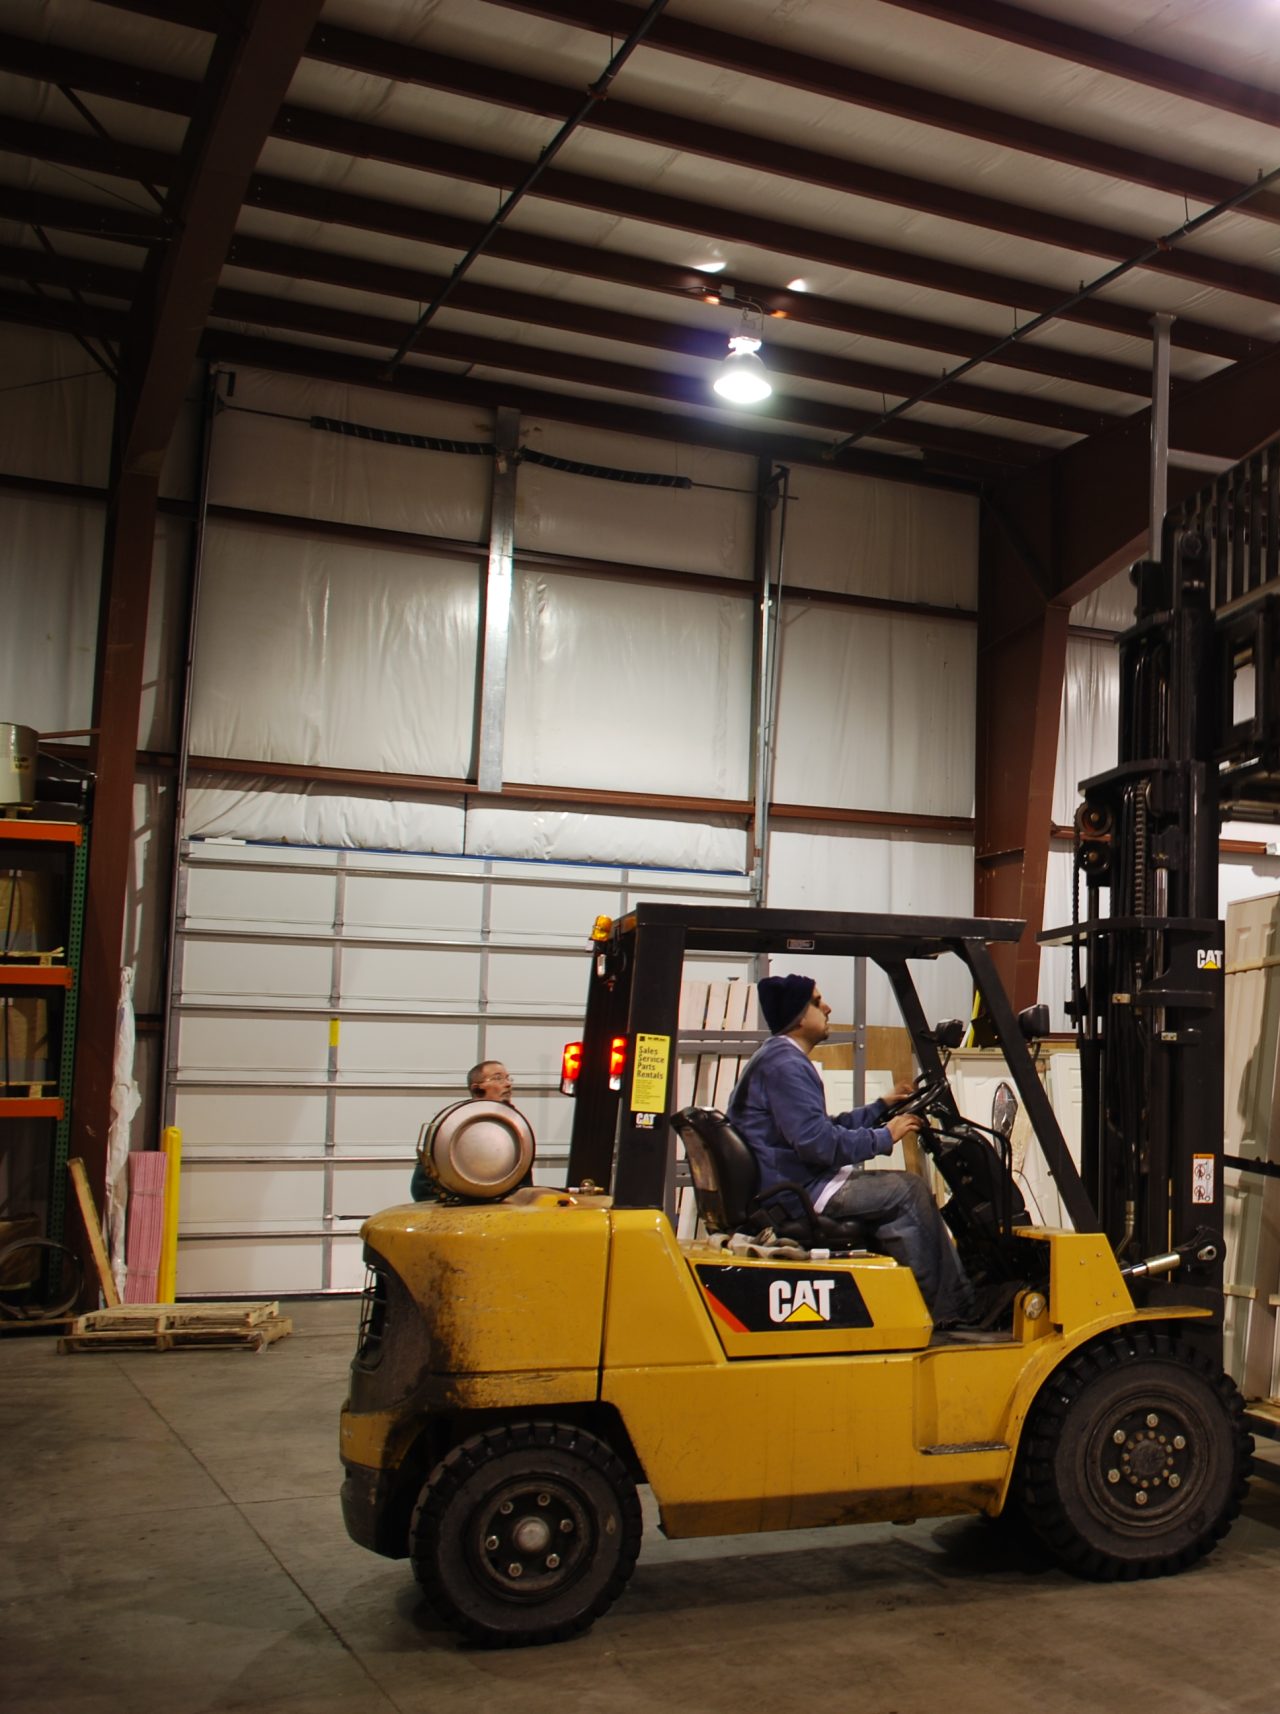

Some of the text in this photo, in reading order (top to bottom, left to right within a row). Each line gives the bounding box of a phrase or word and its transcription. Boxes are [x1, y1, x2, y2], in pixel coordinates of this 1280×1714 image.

[1197, 949, 1223, 968] CAT
[639, 1046, 658, 1055] Sales
[638, 1054, 665, 1064] Service
[638, 1062, 656, 1071] Parts
[637, 1070, 664, 1080] Rentals
[636, 1113, 656, 1125] CAT
[769, 1280, 835, 1323] CAT
